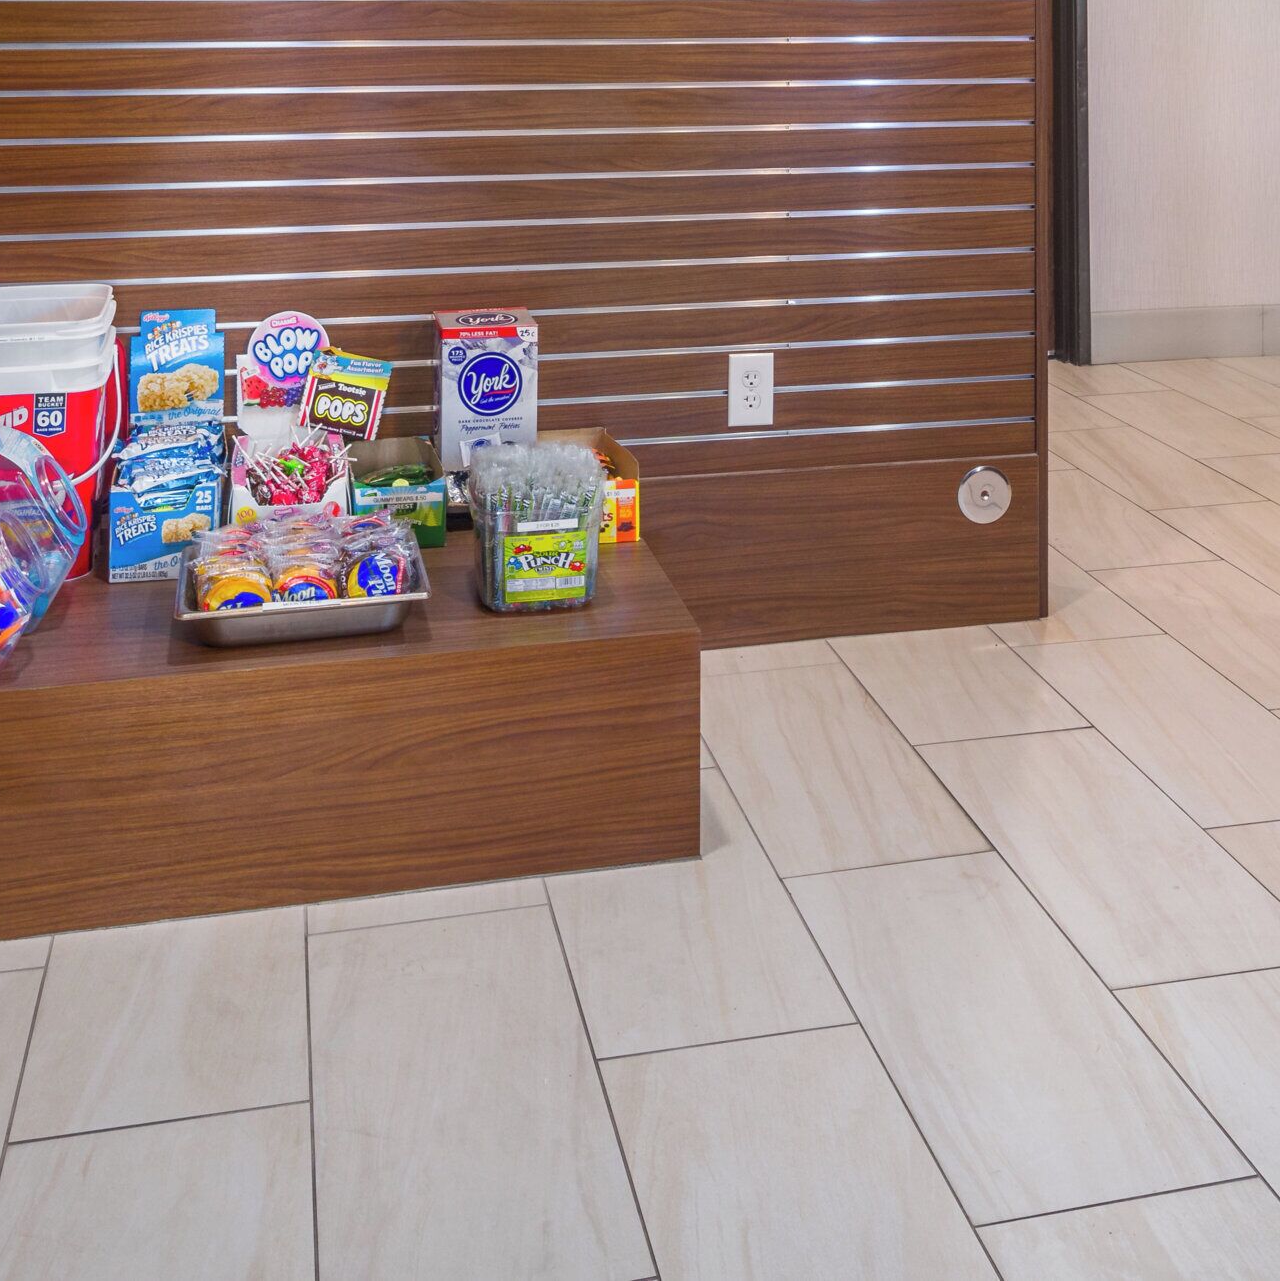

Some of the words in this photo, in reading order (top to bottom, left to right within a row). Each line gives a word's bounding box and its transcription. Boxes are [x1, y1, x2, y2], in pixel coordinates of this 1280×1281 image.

[467, 313, 510, 326] York
[144, 336, 164, 355] RICE
[166, 324, 209, 344] KRISPIES
[254, 327, 319, 363] BLOW
[146, 334, 210, 373] TREATS
[349, 359, 363, 367] Fun
[269, 350, 313, 379] POP
[338, 383, 367, 396] Tootsie
[467, 363, 517, 405] York
[37, 396, 64, 404] TEAM
[316, 395, 367, 423] POPS
[36, 409, 63, 427] 60
[168, 410, 181, 421] the
[183, 406, 222, 418] Original
[460, 424, 496, 436] Peppermint
[499, 422, 521, 431] Patties
[195, 490, 213, 504] 25
[114, 521, 128, 535] RICE
[128, 515, 157, 526] KRISPIES
[116, 522, 157, 546] TREATS
[154, 558, 169, 571] the
[375, 552, 397, 592] Moon
[519, 552, 576, 573] PUNCH
[273, 586, 316, 604] Moon
